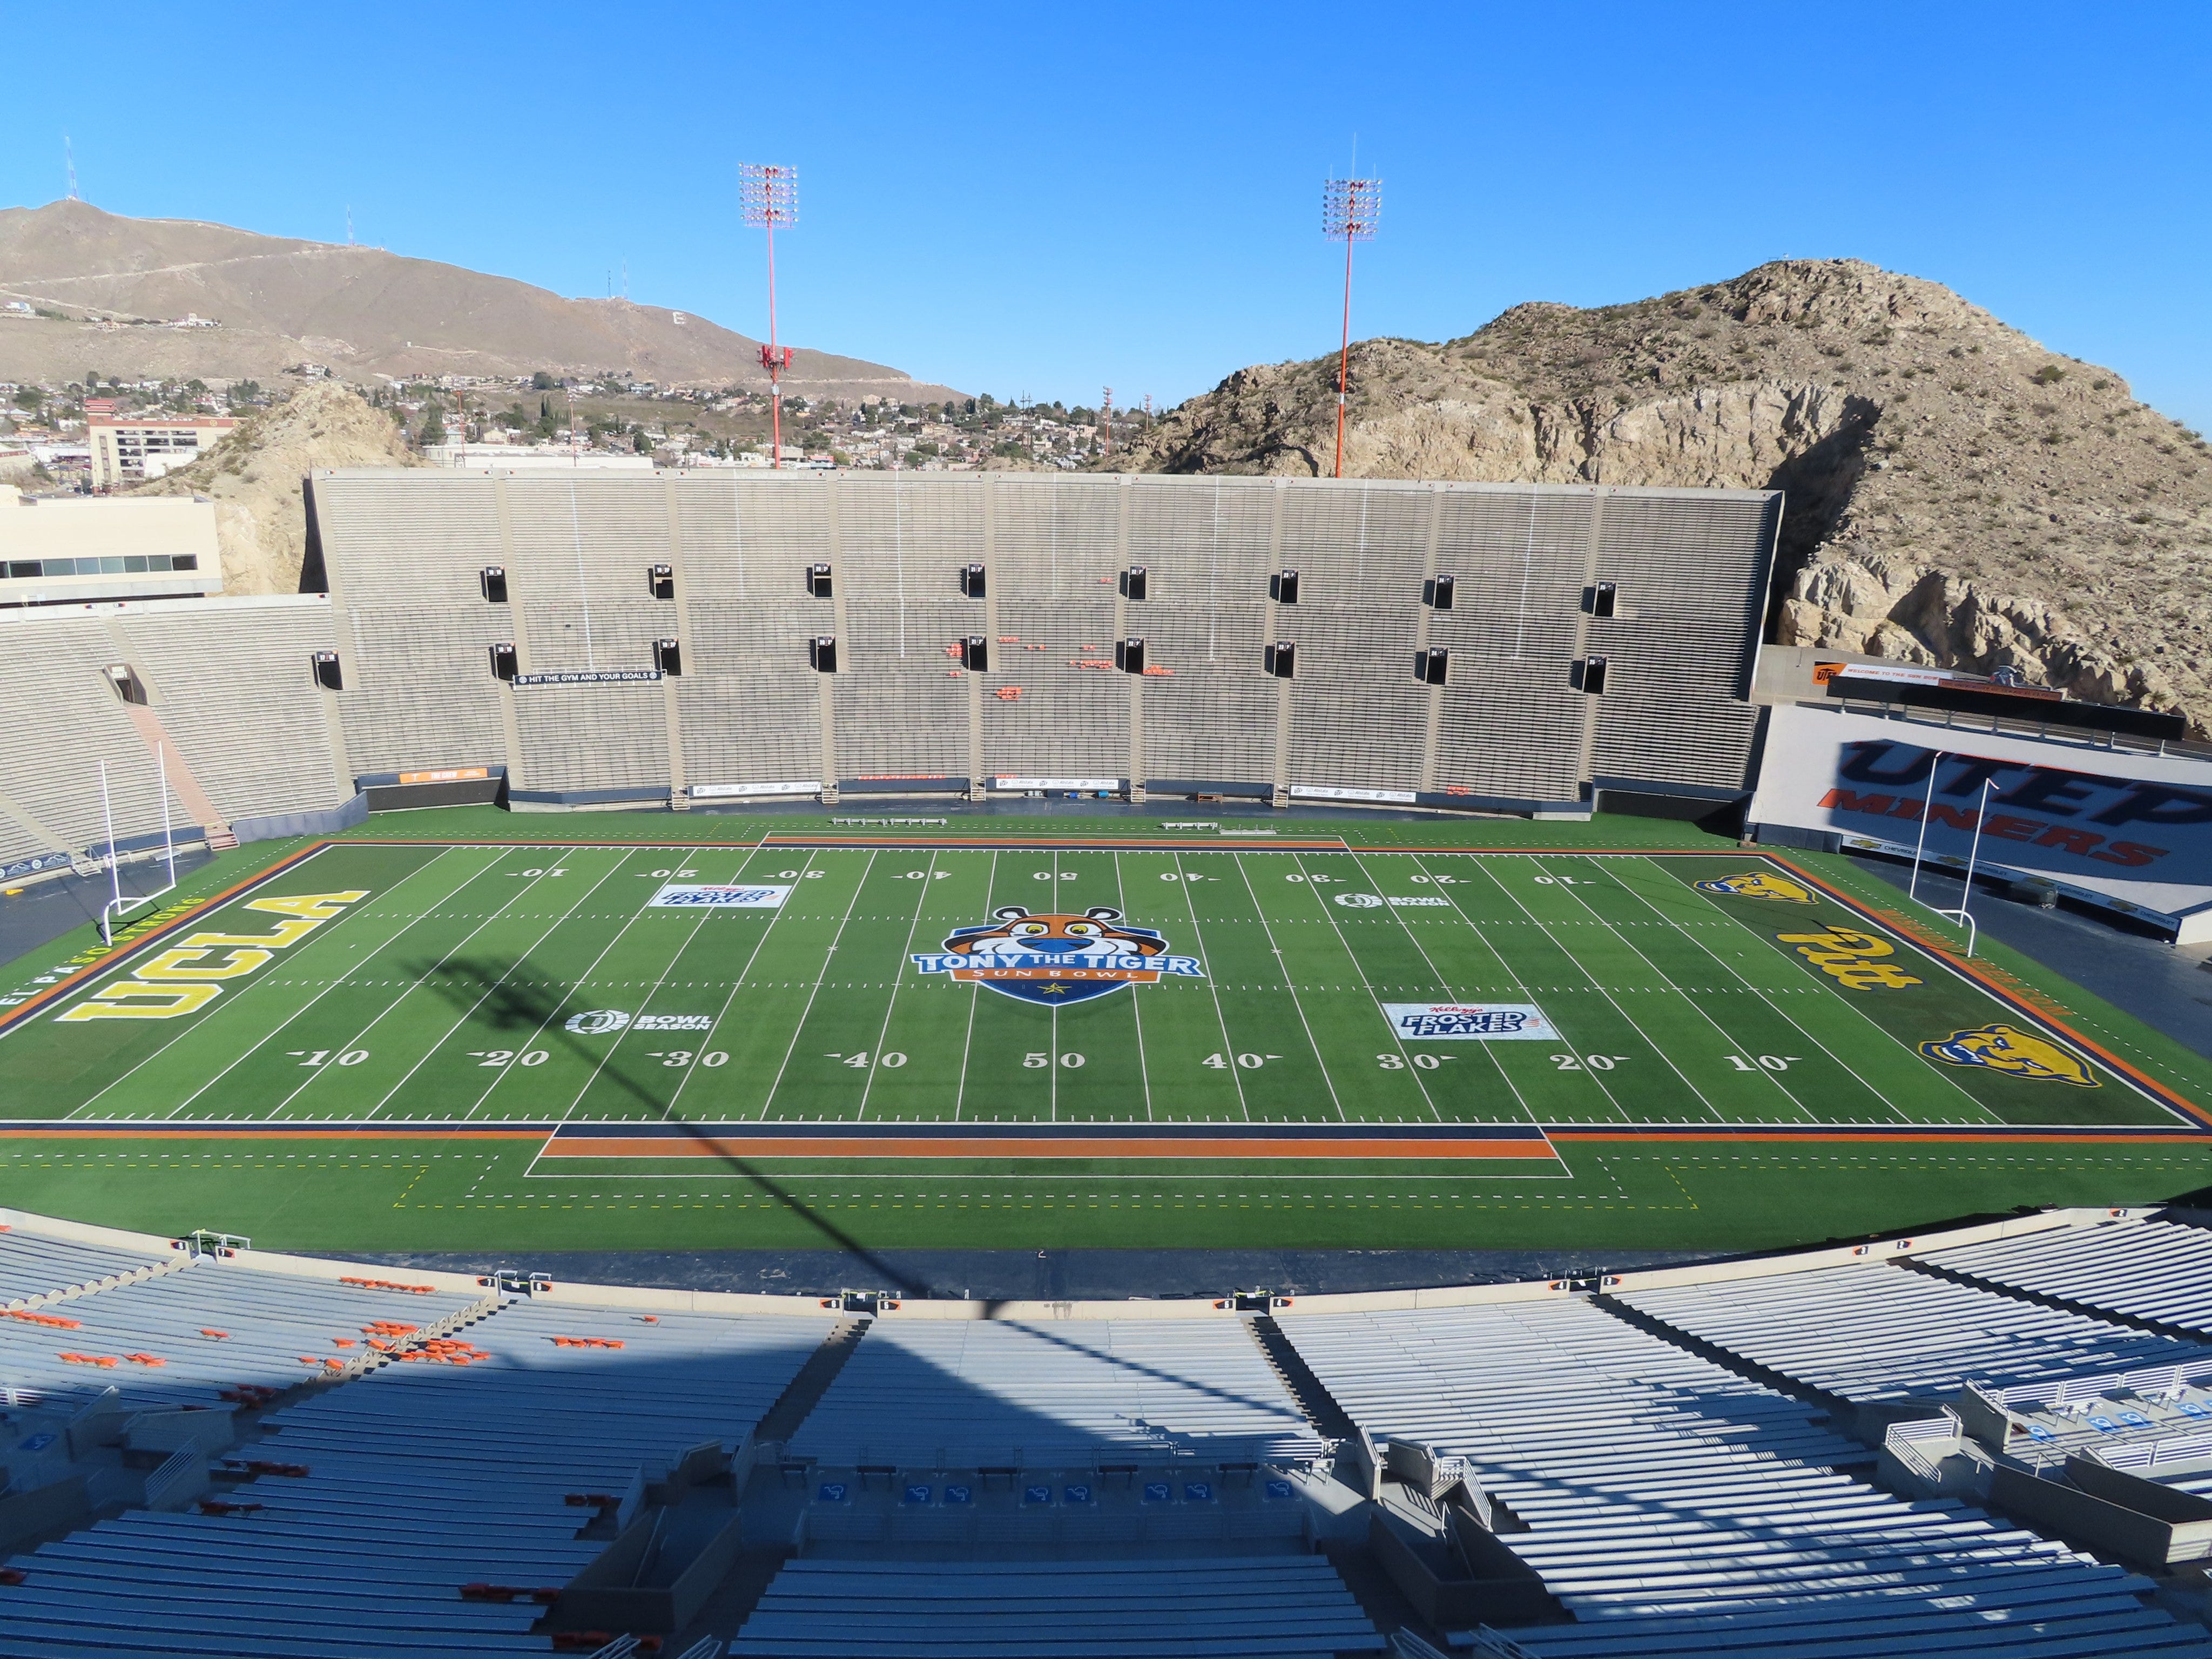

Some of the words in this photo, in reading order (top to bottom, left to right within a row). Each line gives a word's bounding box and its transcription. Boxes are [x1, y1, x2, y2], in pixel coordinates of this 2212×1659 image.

[1840, 741, 2212, 826] UTEP
[1817, 789, 2169, 866] MINERS
[521, 868, 569, 877] 10
[651, 869, 699, 878] 20
[779, 870, 826, 879] 30
[906, 871, 952, 880] 40
[1033, 872, 1078, 881] 50
[1160, 873, 1204, 881] 40
[1285, 874, 1330, 882] 30
[1410, 875, 1456, 884] 20
[1534, 876, 1584, 885] 10
[1, 989, 43, 1005] EL
[33, 947, 112, 983] PASO
[112, 898, 206, 941] STRONG
[53, 890, 372, 1022] UCLA
[1776, 926, 1923, 990] Pitt
[919, 955, 1023, 972] TONY
[1033, 954, 1076, 964] THE
[1083, 955, 1195, 975] TIGER
[972, 969, 1032, 977] SUN
[1049, 970, 1138, 979] BOWL
[1405, 1012, 1523, 1026] FROSTED
[1419, 1021, 1519, 1035] FLAKES
[299, 1050, 369, 1067] 10
[478, 1050, 550, 1067] 20
[662, 1051, 729, 1067] 30
[844, 1052, 907, 1068] 40
[1023, 1053, 1085, 1069] 50
[1202, 1053, 1263, 1069] 40
[1377, 1054, 1440, 1070] 30
[1549, 1055, 1615, 1071] 20
[1723, 1055, 1788, 1071] 10
